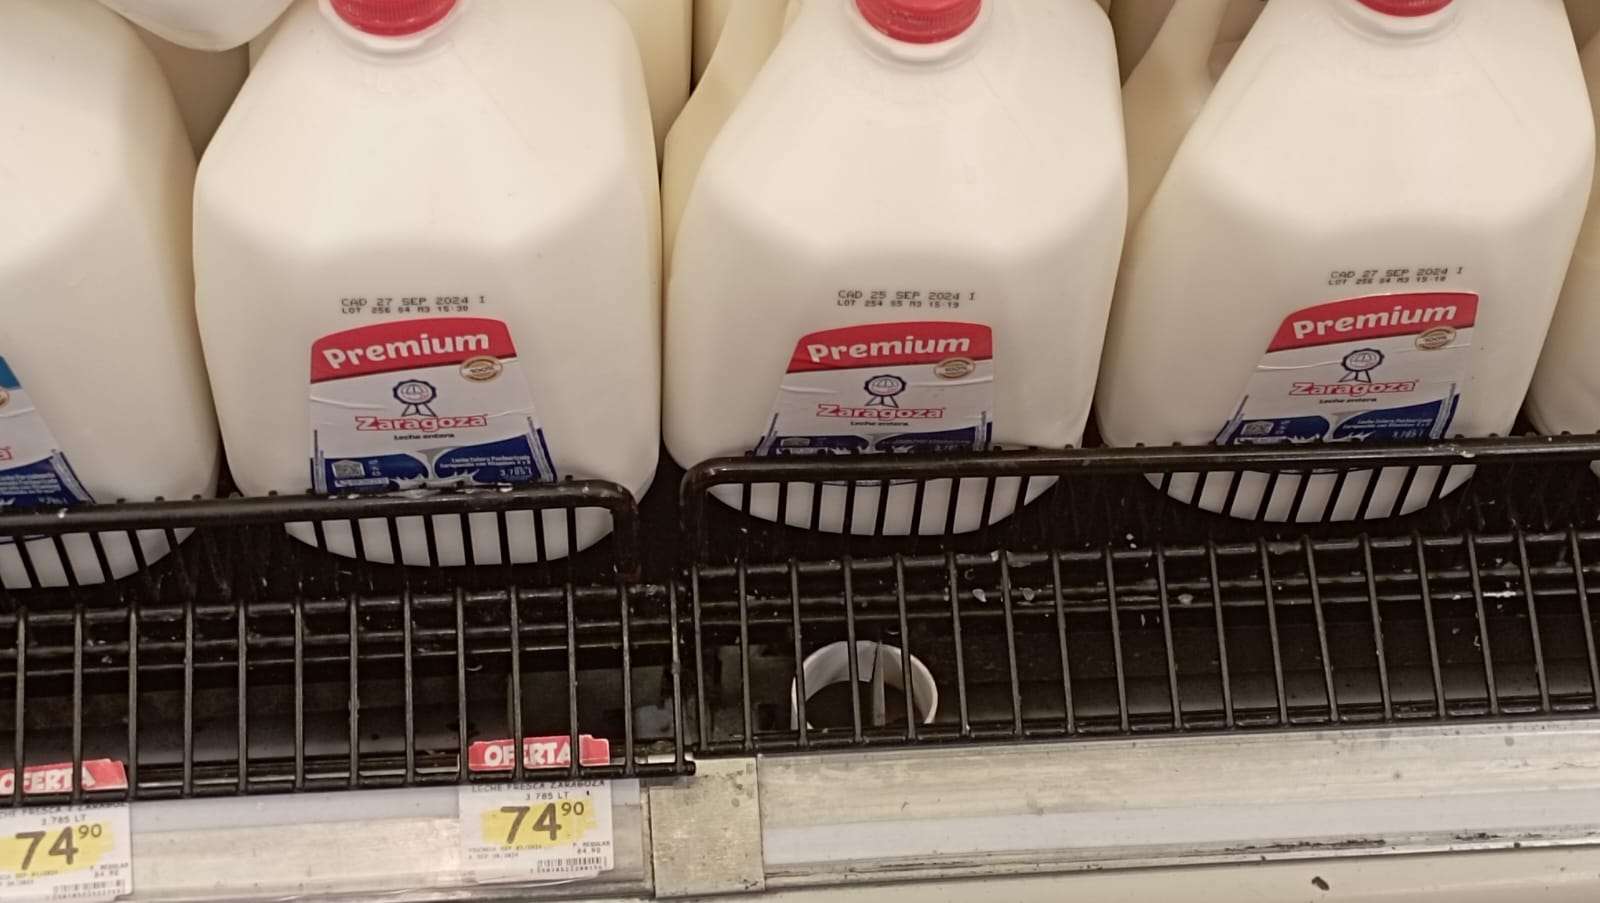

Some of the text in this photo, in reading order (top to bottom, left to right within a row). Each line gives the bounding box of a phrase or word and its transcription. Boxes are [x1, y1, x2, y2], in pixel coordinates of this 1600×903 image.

[1330, 271, 1356, 279] CAD
[1361, 270, 1379, 278] 27
[1385, 269, 1410, 277] SEP
[1416, 267, 1449, 276] 2024
[341, 298, 368, 307] CAD
[376, 297, 393, 307] 27
[401, 297, 428, 306] SEP
[435, 296, 469, 306] 2024
[838, 290, 863, 299] CAD
[870, 291, 888, 300] 25
[895, 291, 921, 300] SEP
[927, 291, 961, 301] 2024
[371, 306, 392, 314] 256
[1292, 305, 1458, 340] Premium
[322, 333, 490, 369] Premium
[807, 336, 970, 363] Premium
[1289, 380, 1416, 397] Zaragoza
[816, 404, 945, 421] Zaragoza
[355, 414, 488, 432] Zaragoza
[472, 784, 502, 793] LECHE
[506, 782, 545, 791] FRESCA
[557, 791, 569, 800] LT
[500, 801, 585, 844] 74 90
[15, 823, 103, 871] 74 90
